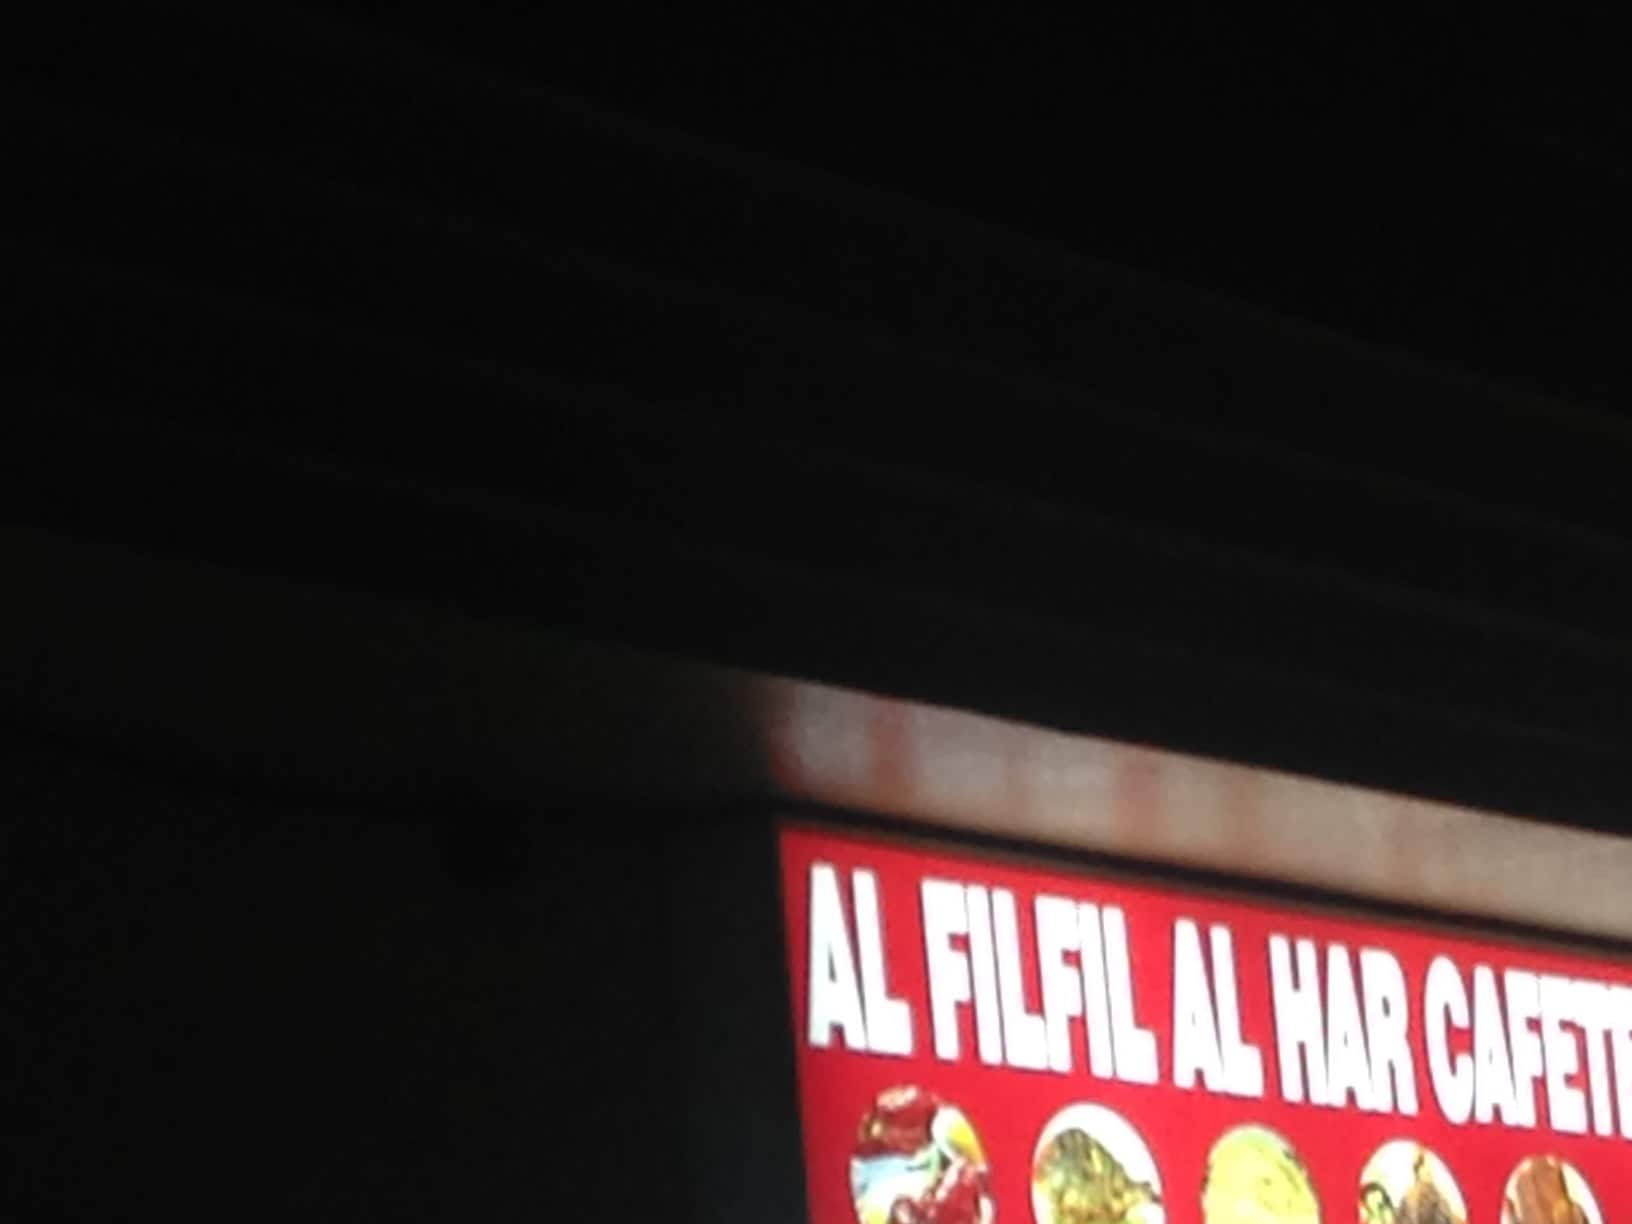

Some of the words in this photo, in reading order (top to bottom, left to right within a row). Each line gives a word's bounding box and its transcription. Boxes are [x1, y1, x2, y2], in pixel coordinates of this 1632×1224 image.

[808, 857, 912, 1055] AL
[920, 878, 1158, 1085] FILFIL
[1172, 917, 1263, 1098] AL
[1268, 934, 1419, 1117] HAR
